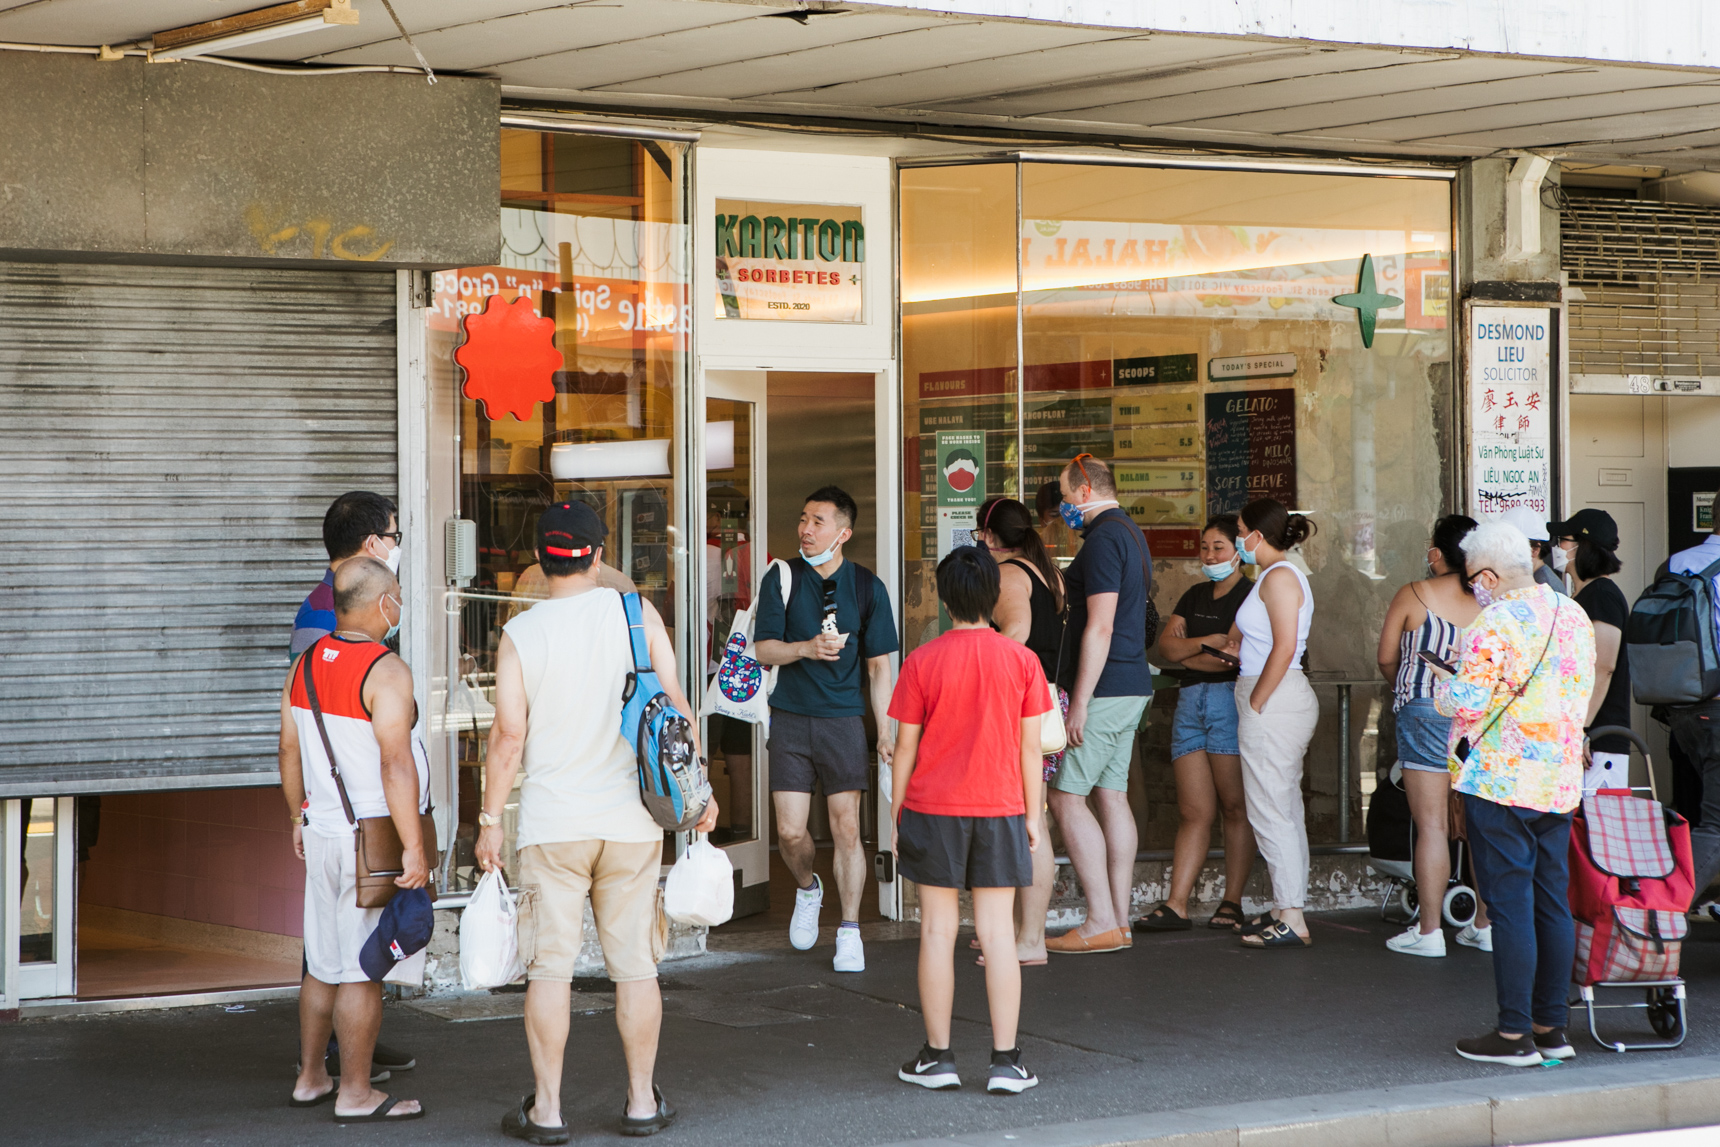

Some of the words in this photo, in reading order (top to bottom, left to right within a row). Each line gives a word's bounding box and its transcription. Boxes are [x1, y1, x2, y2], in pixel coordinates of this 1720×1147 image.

[715, 214, 865, 262] KARITON
[738, 268, 841, 285] SORBETES
[768, 302, 791, 310] ESTD.
[793, 302, 811, 310] 2020
[1478, 323, 1544, 340] DESMOND
[1498, 346, 1524, 362] LIEU
[1222, 363, 1251, 371] TODAY'S
[1254, 361, 1284, 369] SPECIAL
[1118, 367, 1155, 379] SCOOPS
[1483, 367, 1537, 381] SOLICITOR
[924, 380, 966, 391] FLAVOURS
[1629, 376, 1650, 393] 48
[1226, 397, 1278, 413] GELATO:
[924, 416, 937, 425] UBE
[1023, 411, 1042, 420] ANGO
[1043, 410, 1066, 419] FLOAT
[1023, 444, 1038, 453] ESO
[1119, 440, 1132, 449] ISA
[1179, 438, 1193, 447] 5.5
[1265, 444, 1291, 457] MILO
[1180, 472, 1194, 480] 7.5
[1214, 476, 1242, 490] SOFT
[1245, 473, 1288, 488] SERVE:
[1528, 470, 1539, 483] AN
[1183, 540, 1195, 549] 25
